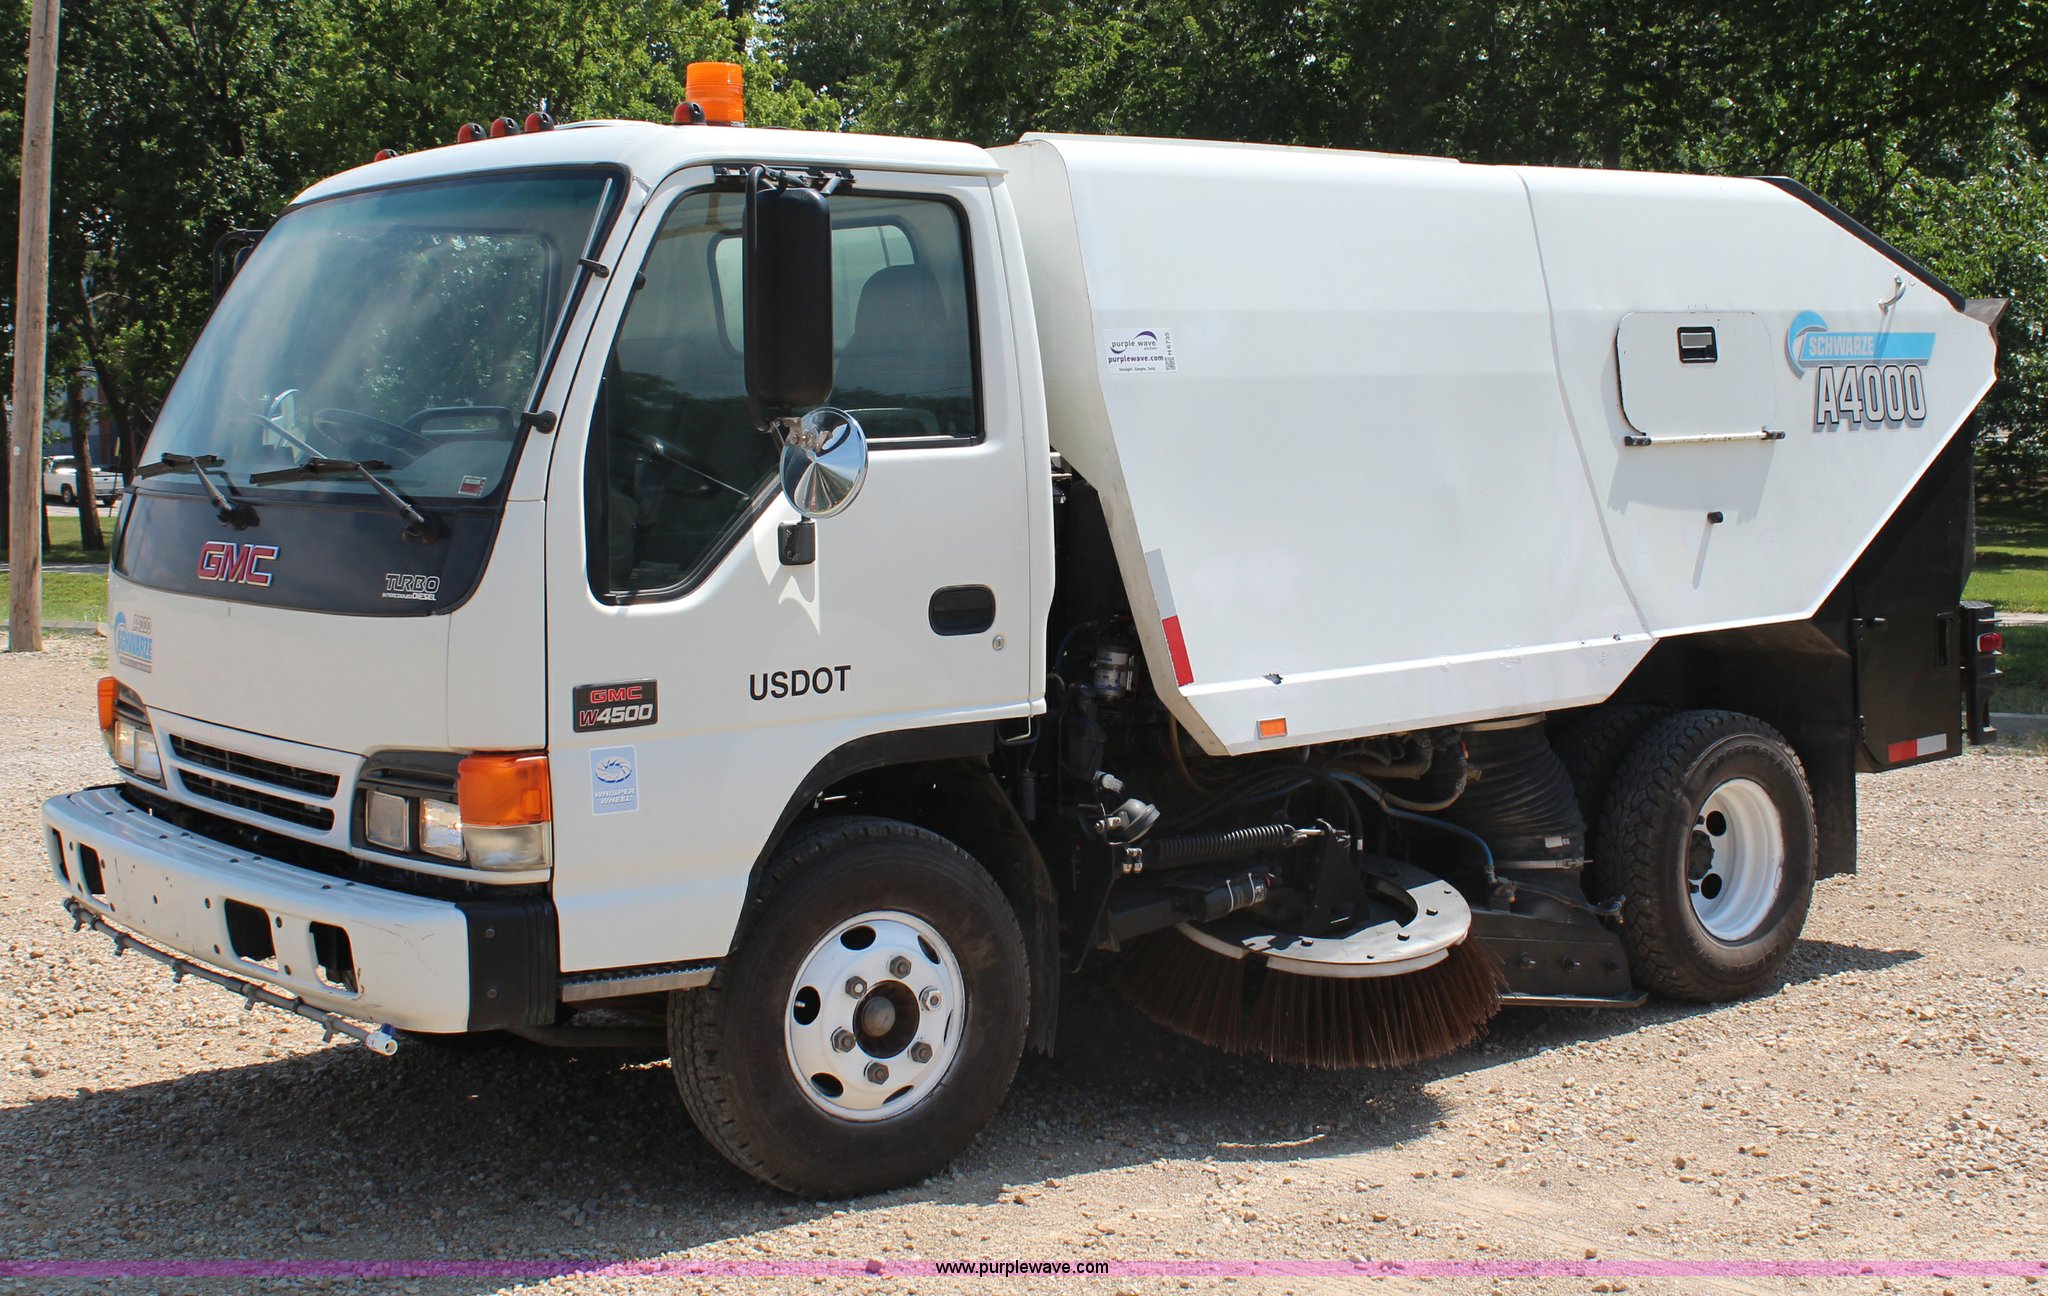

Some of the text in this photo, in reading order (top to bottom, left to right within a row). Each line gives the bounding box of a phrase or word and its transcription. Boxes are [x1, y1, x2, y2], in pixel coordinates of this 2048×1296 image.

[1112, 339, 1135, 348] purple
[1809, 335, 1874, 356] SCHWARZE
[1108, 355, 1164, 364] purplewave.com
[1814, 364, 1927, 425] A4000
[198, 540, 280, 587] GMC
[385, 573, 440, 594] TURBO
[412, 592, 437, 601] DIESEL
[750, 664, 852, 701] USDOT
[590, 685, 643, 704] GMC
[580, 704, 654, 727] W4500
[594, 788, 636, 799] WHISPER
[600, 795, 633, 806] WHEEL
